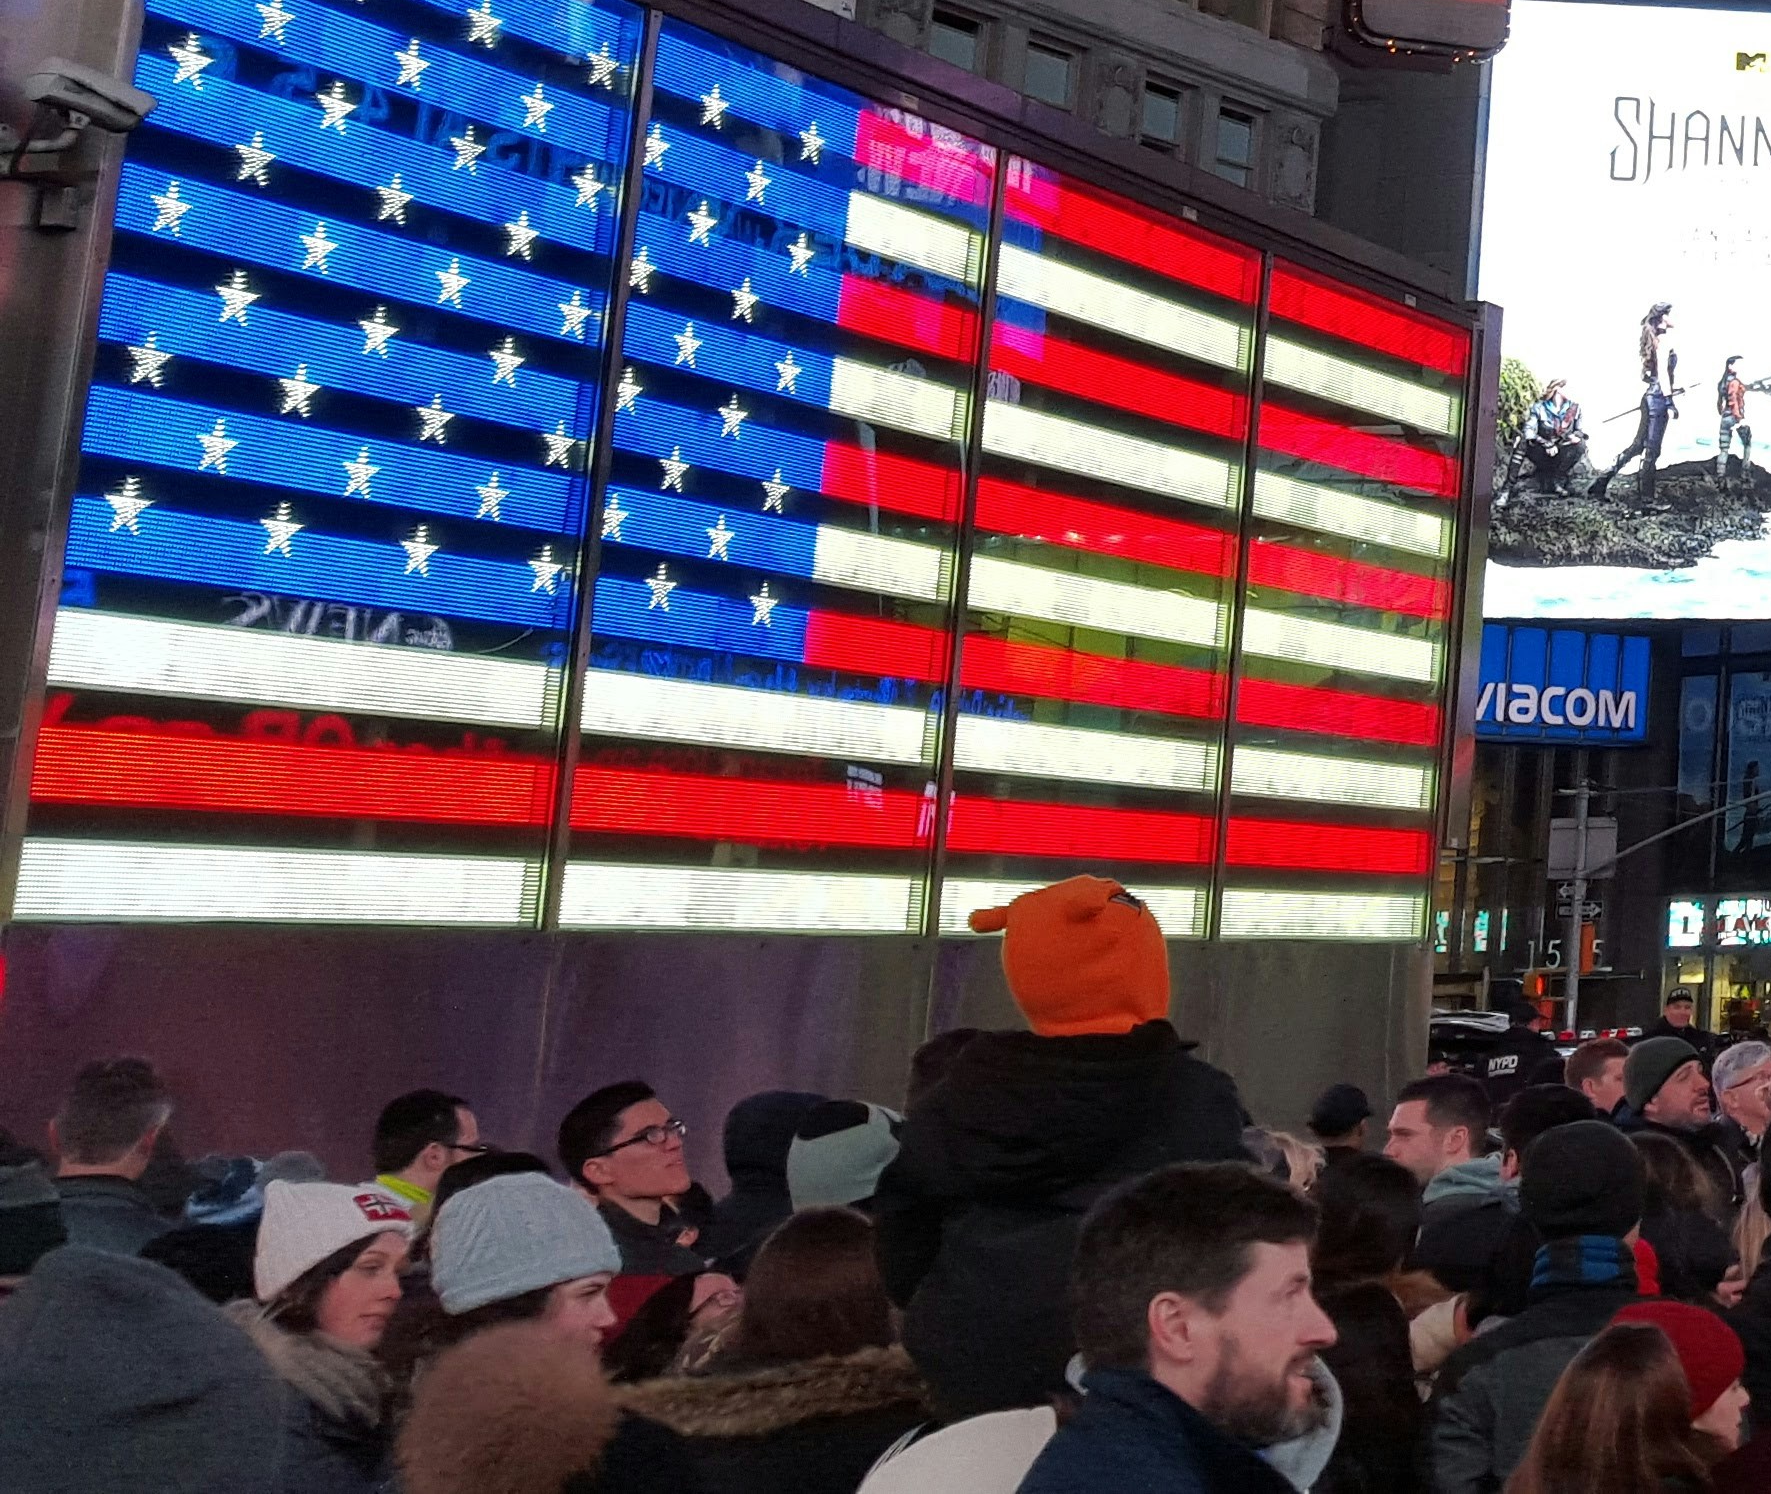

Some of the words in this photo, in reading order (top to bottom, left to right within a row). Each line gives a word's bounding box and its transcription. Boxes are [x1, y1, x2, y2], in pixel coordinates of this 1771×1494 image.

[1476, 682, 1637, 729] VIACOM
[1527, 938, 1606, 971] 155
[1488, 1054, 1519, 1070] NYPD
